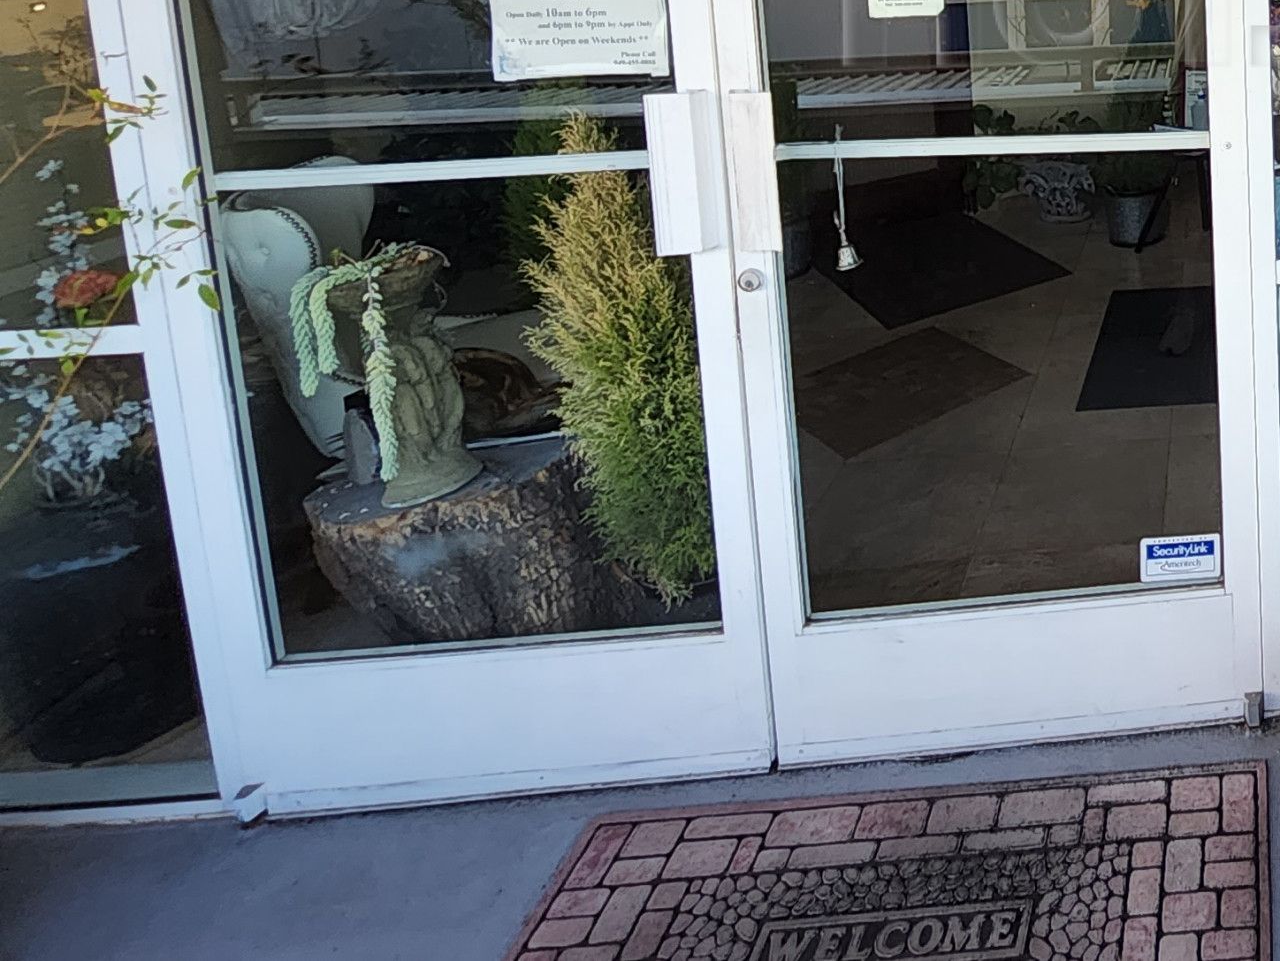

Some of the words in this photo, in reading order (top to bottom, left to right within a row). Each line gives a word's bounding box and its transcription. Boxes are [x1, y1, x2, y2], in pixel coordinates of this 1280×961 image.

[505, 11, 525, 19] Open
[545, 8, 572, 18] 10am
[574, 9, 584, 17] to
[585, 9, 607, 20] 6pm
[586, 21, 606, 31] 9pm
[518, 37, 533, 46] We
[535, 38, 549, 46] are
[552, 37, 576, 47] Open
[591, 35, 637, 45] Weekends
[1153, 542, 1209, 557] SecurityLink
[768, 912, 1017, 961] WELCOME
